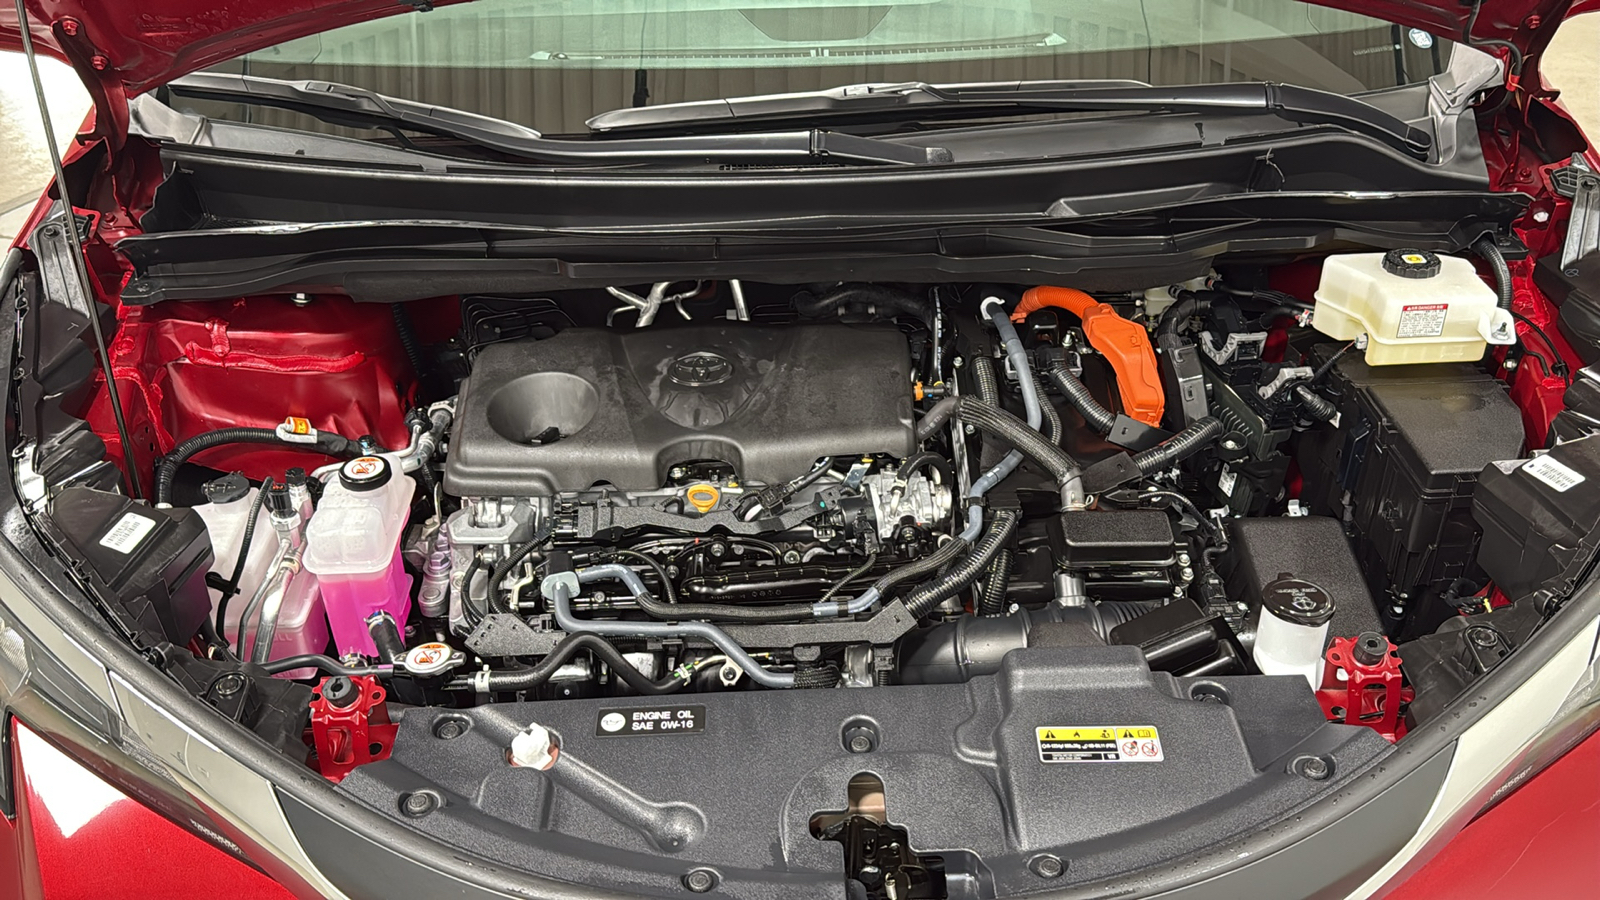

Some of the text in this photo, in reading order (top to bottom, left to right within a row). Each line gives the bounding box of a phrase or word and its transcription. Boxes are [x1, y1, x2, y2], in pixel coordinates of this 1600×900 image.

[632, 710, 694, 720] ENGINE OIL
[632, 720, 694, 730] SAE 0W-16
